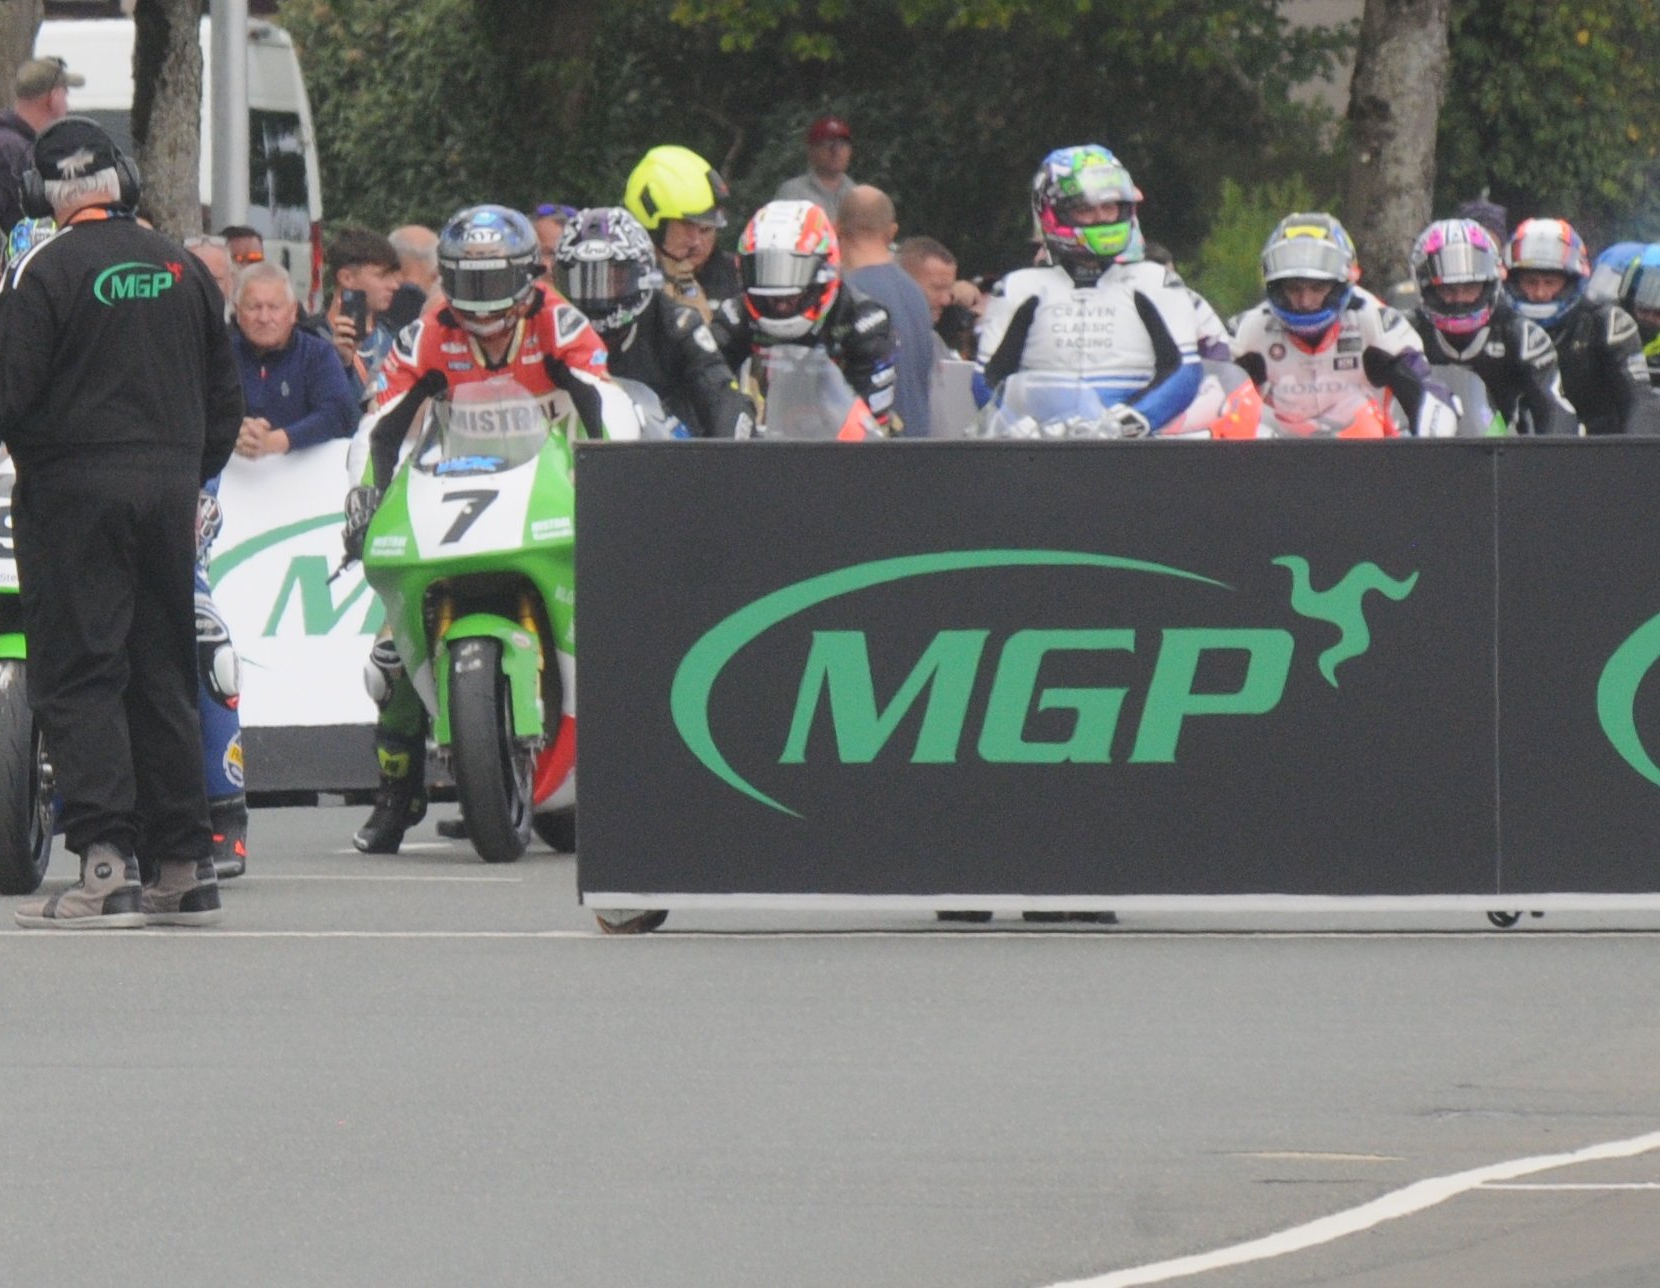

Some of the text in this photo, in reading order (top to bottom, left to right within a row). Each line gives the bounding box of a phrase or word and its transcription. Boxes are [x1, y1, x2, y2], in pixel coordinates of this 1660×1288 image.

[110, 271, 172, 299] MGP
[440, 489, 500, 546] 7
[777, 628, 1295, 764] MGP
